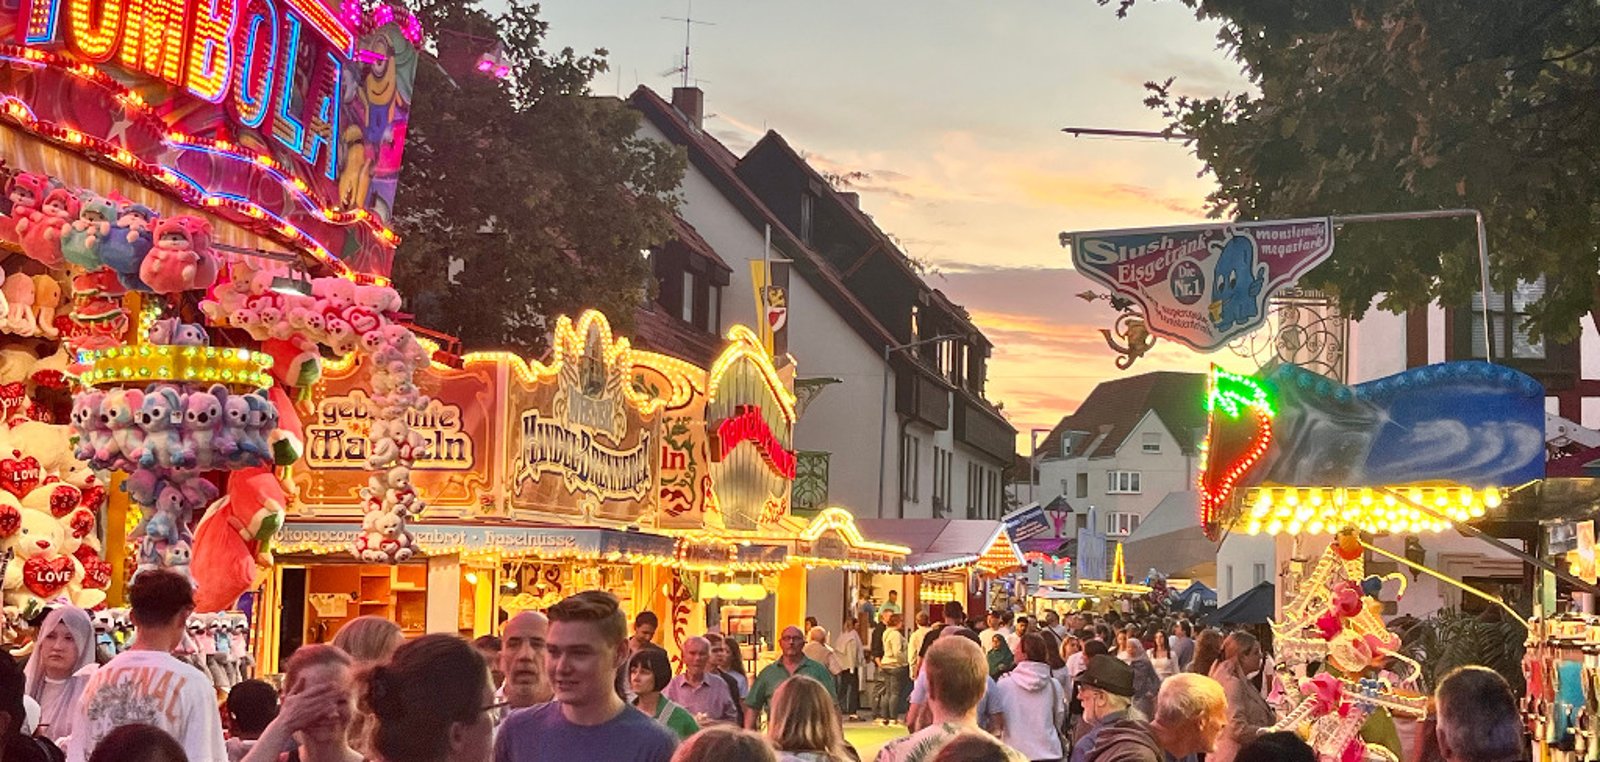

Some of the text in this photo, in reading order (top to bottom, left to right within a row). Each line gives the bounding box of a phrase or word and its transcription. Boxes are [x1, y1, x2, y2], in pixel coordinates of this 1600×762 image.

[1083, 235, 1174, 265] Slush
[1179, 263, 1196, 277] Die
[322, 402, 455, 428] gebnte
[310, 429, 466, 461] Maln
[13, 468, 39, 482] LOVE
[275, 526, 359, 544] okopopcor
[415, 528, 467, 546] enbrot
[36, 570, 71, 583] LOVE
